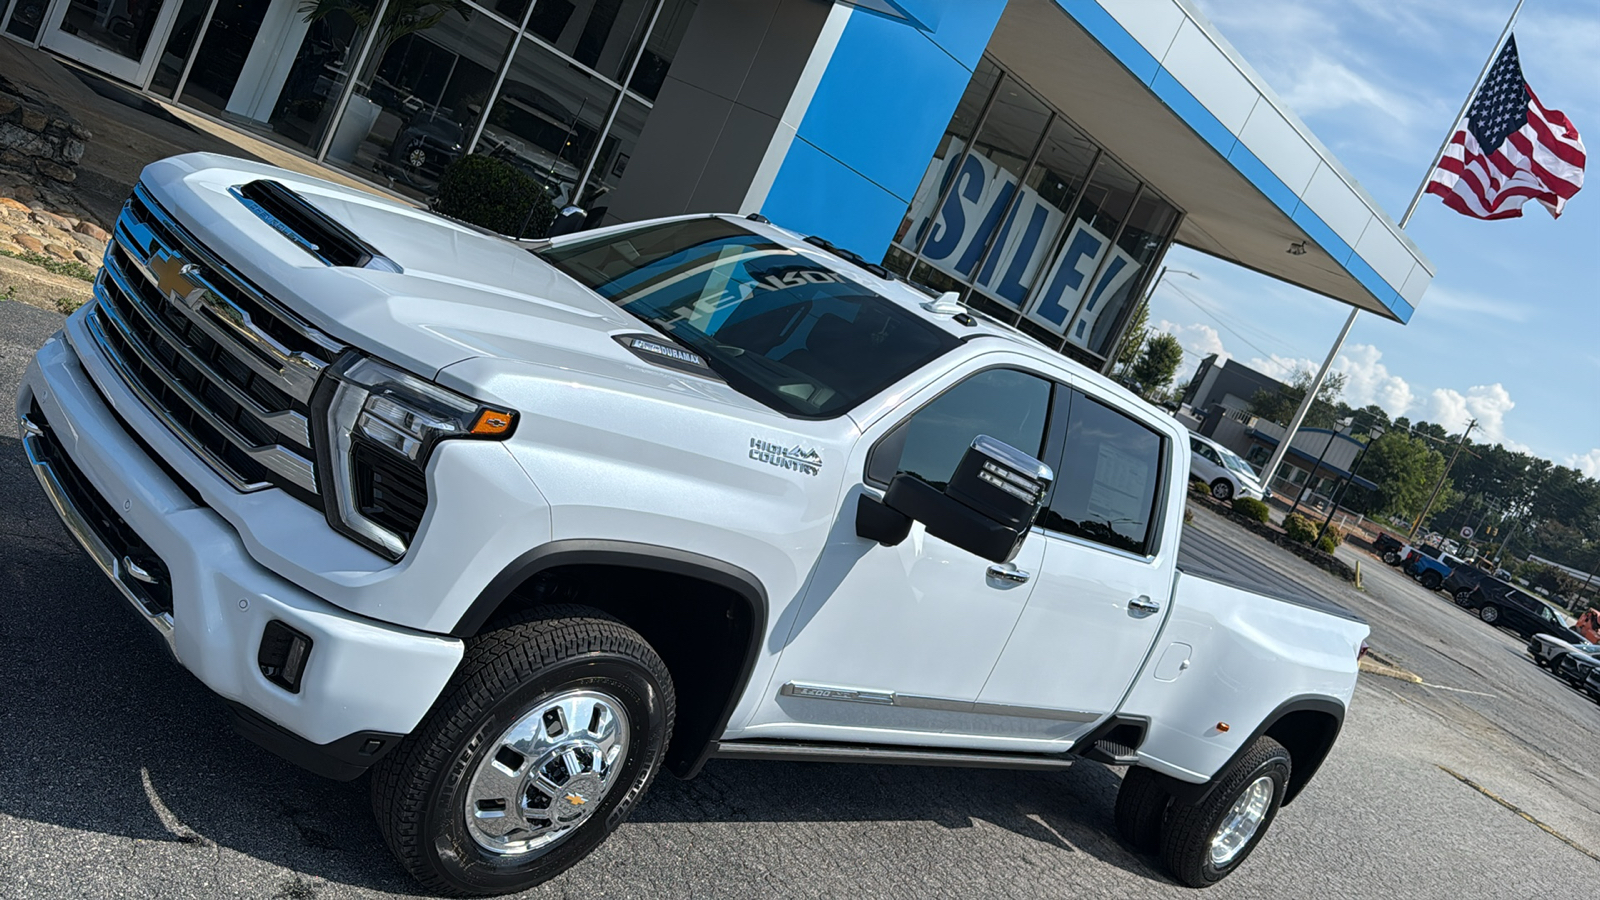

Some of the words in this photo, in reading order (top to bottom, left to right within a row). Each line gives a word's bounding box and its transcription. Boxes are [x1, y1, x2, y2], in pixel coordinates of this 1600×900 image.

[915, 152, 1128, 341] SALE!
[661, 345, 700, 364] DURAMAX
[748, 448, 820, 477] COUNTRY
[749, 437, 788, 457] HIGH
[442, 720, 495, 812] MICHELIN
[608, 749, 656, 826] MICHELIN
